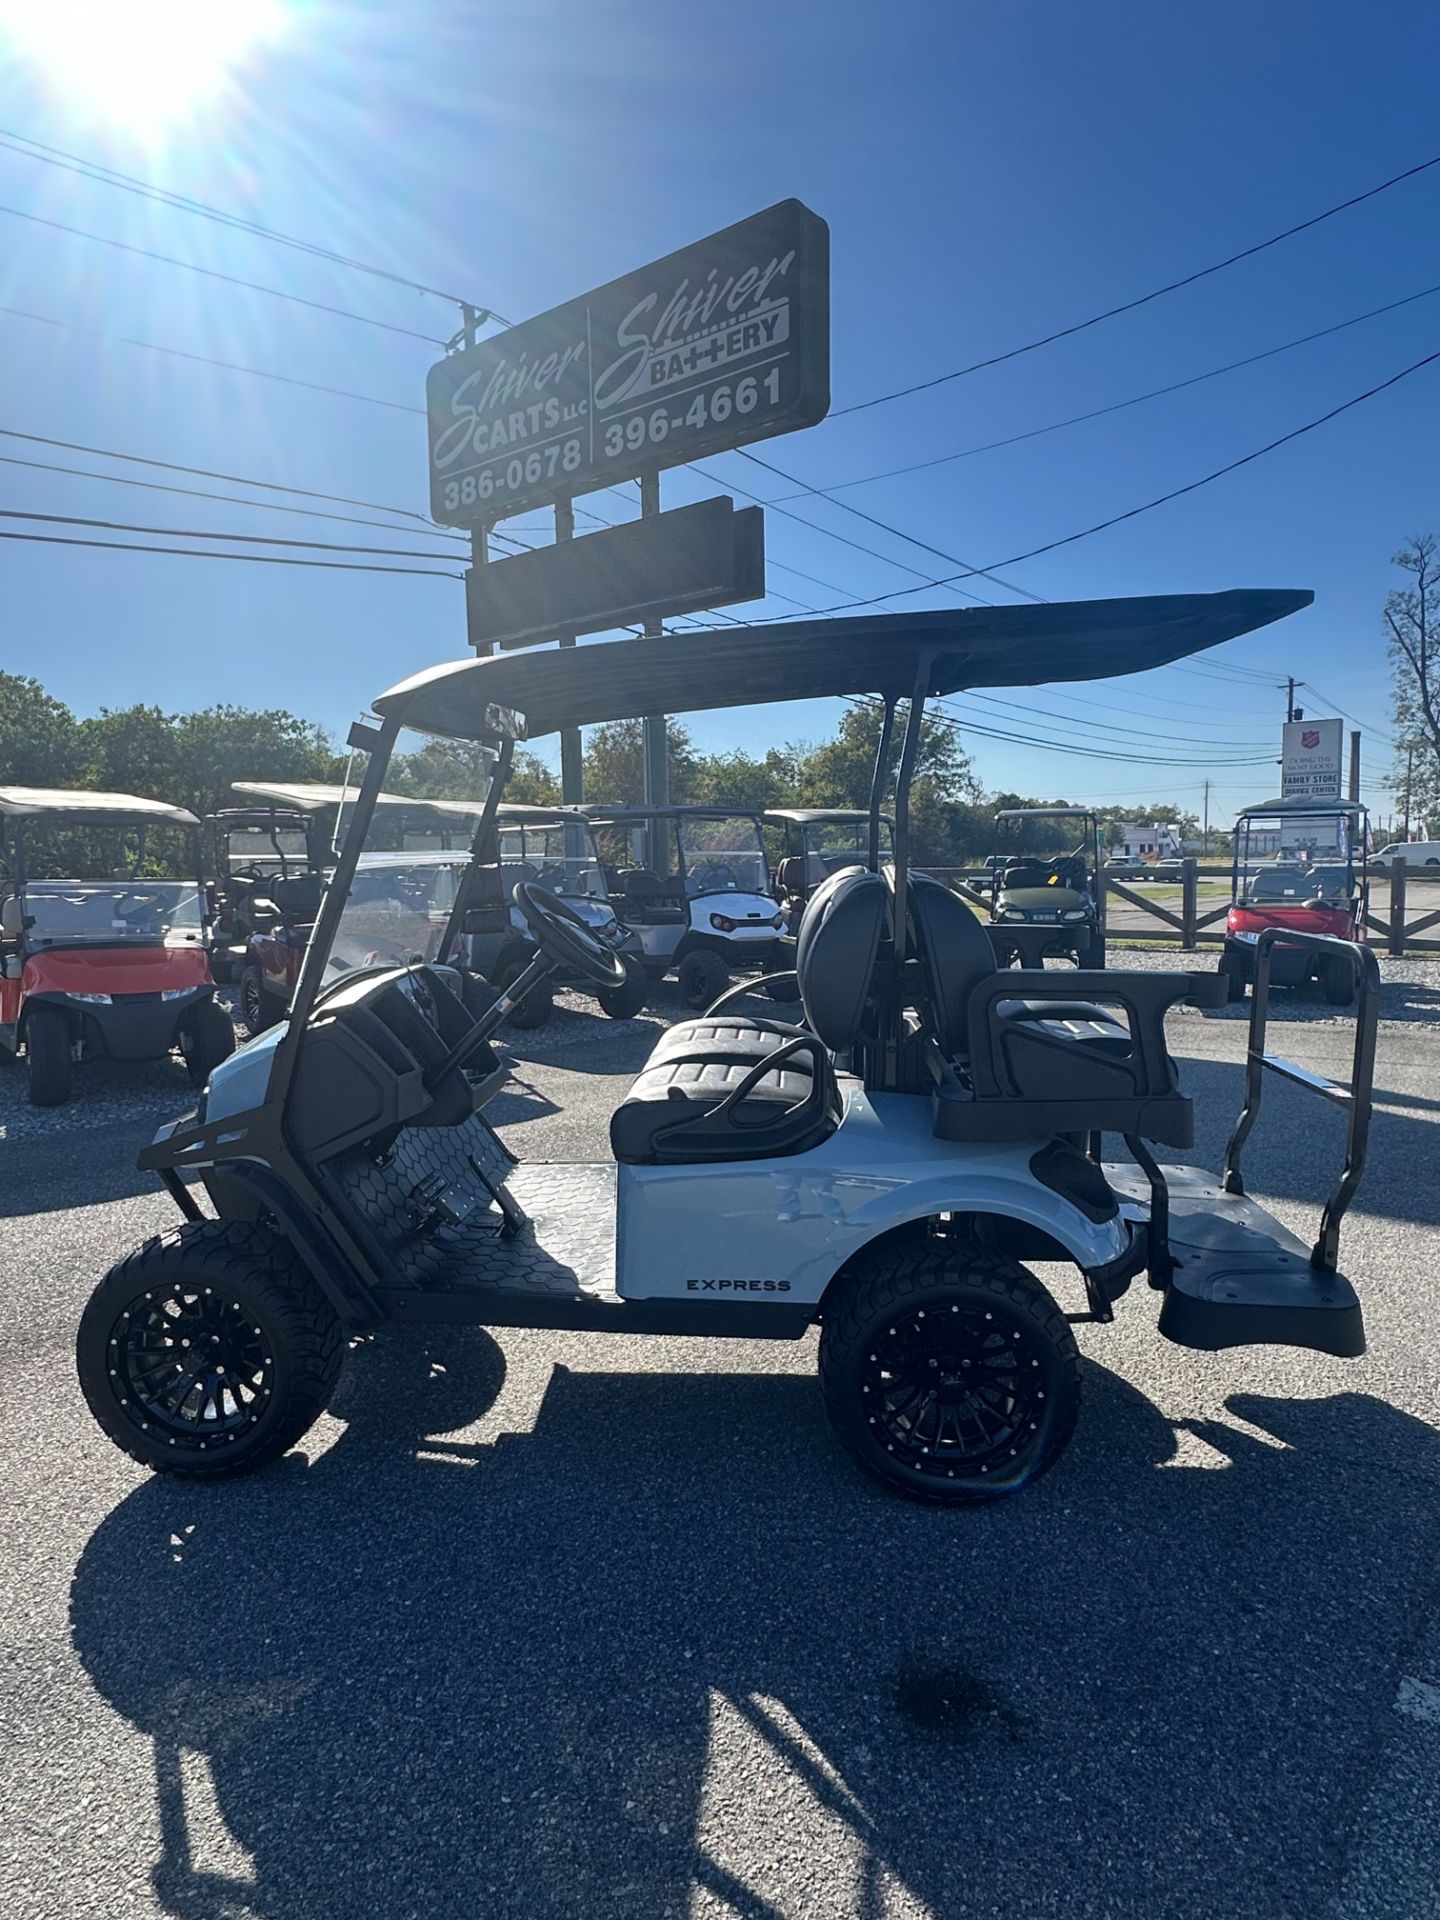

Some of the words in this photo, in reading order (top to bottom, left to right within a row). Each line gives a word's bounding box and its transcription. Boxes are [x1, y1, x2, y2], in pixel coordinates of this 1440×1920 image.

[594, 250, 795, 410] Shiver
[434, 341, 586, 469] Shiver
[473, 397, 560, 454] CARTS
[563, 400, 588, 422] LLC
[604, 367, 780, 458] 396-4661
[444, 439, 582, 511] 386-0678
[1284, 776, 1310, 785] FAMILY
[1312, 774, 1337, 783] STORE
[686, 1279, 791, 1292] EXPRESS
